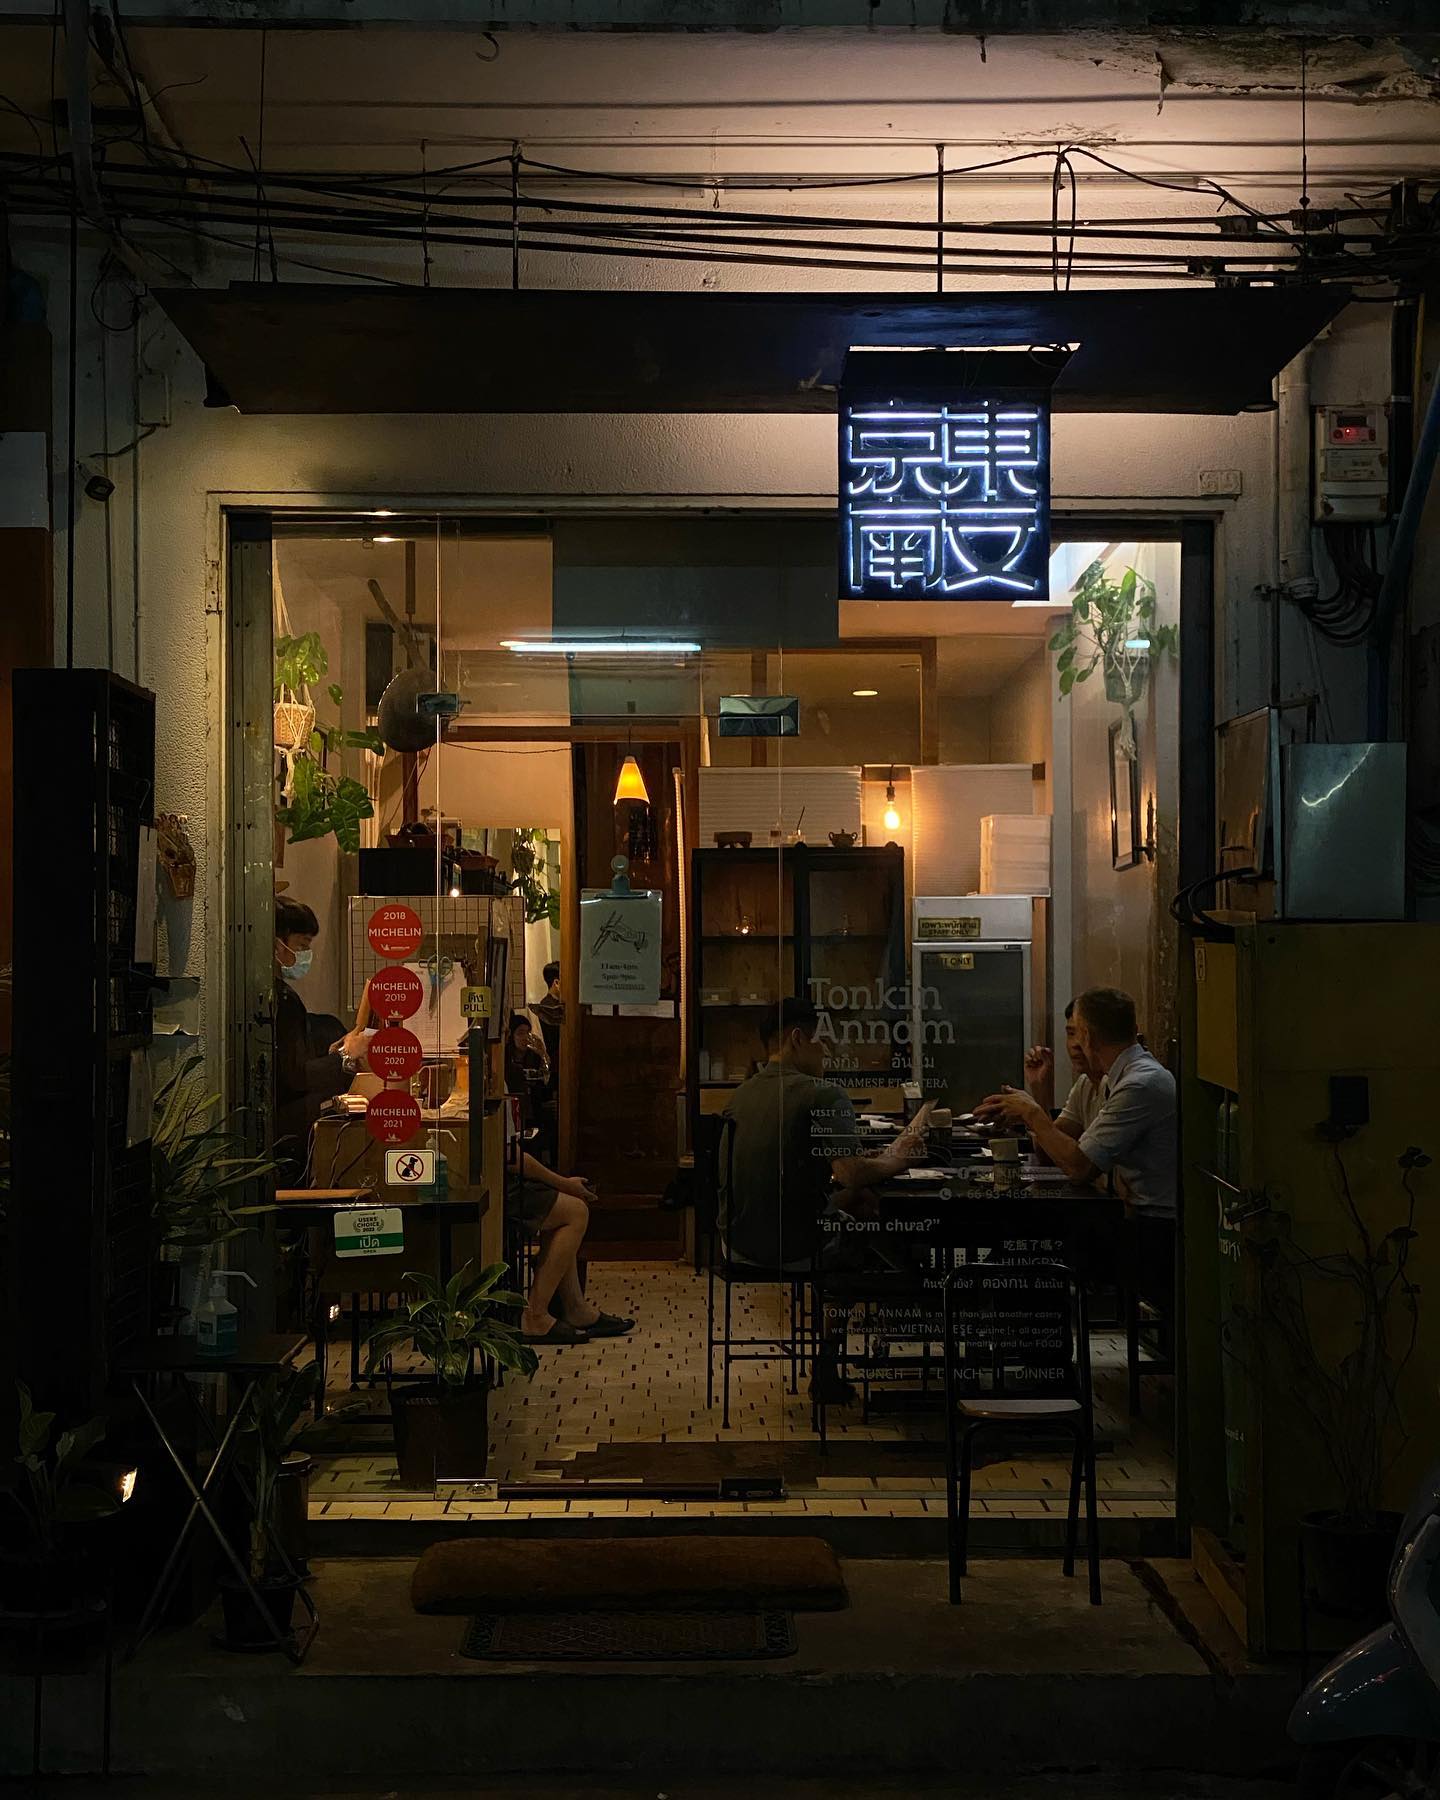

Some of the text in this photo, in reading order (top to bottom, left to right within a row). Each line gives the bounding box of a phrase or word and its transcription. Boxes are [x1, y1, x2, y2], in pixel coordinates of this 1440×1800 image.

[383, 911, 407, 920] 2018
[368, 927, 422, 937] MICHELIN
[371, 982, 420, 992] MICHELIN
[384, 993, 407, 1002] 2019
[807, 977, 943, 1011] Tonkin
[463, 1004, 488, 1013] PULL
[810, 1011, 957, 1045] Annam
[371, 1045, 418, 1054] MICHELIN
[384, 1056, 405, 1065] 2020
[813, 1077, 885, 1089] VIETNAMESE
[370, 1107, 417, 1117] MICHELIN
[810, 1109, 837, 1118] VISIT
[383, 1119, 403, 1128] 2021
[810, 1125, 833, 1134] from
[811, 1147, 851, 1157] CLOSED
[359, 1235, 380, 1249] เปิด
[824, 1307, 866, 1319] TONKIN
[878, 1308, 922, 1319] ANNAM
[900, 1323, 974, 1335] VIETNAESE
[1035, 1339, 1064, 1349] FOOD
[936, 1367, 982, 1380] LNCH
[1015, 1367, 1065, 1380] DINNER
